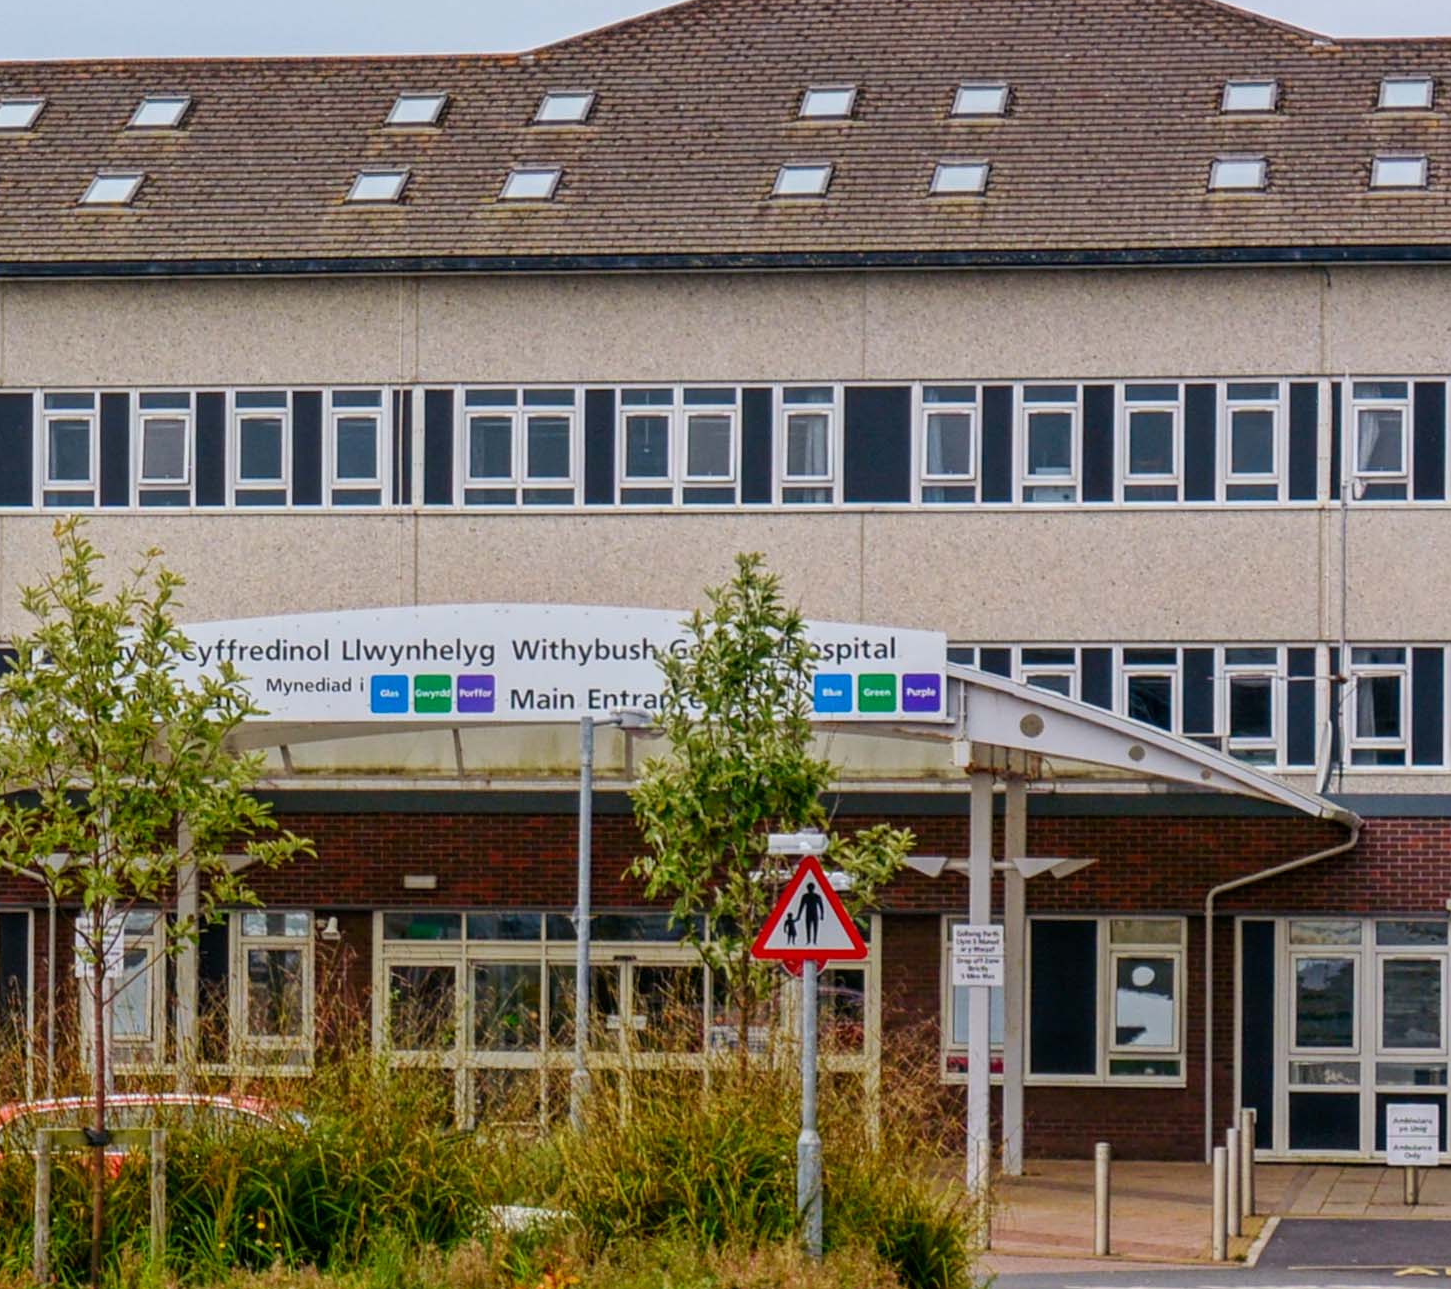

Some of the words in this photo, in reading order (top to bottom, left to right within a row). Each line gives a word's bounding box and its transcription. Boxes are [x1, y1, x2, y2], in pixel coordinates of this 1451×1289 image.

[181, 638, 330, 667] Cyffredinol
[342, 637, 496, 667] Llwynhelyg
[511, 637, 657, 667] Withybush
[265, 677, 352, 697] Mynediad
[360, 677, 365, 693] i
[379, 688, 400, 699] Glas
[821, 686, 844, 698] Blue
[862, 686, 892, 698] Green
[905, 686, 937, 699] Purple
[414, 688, 452, 701] Gwyrdd
[509, 687, 575, 710] Main
